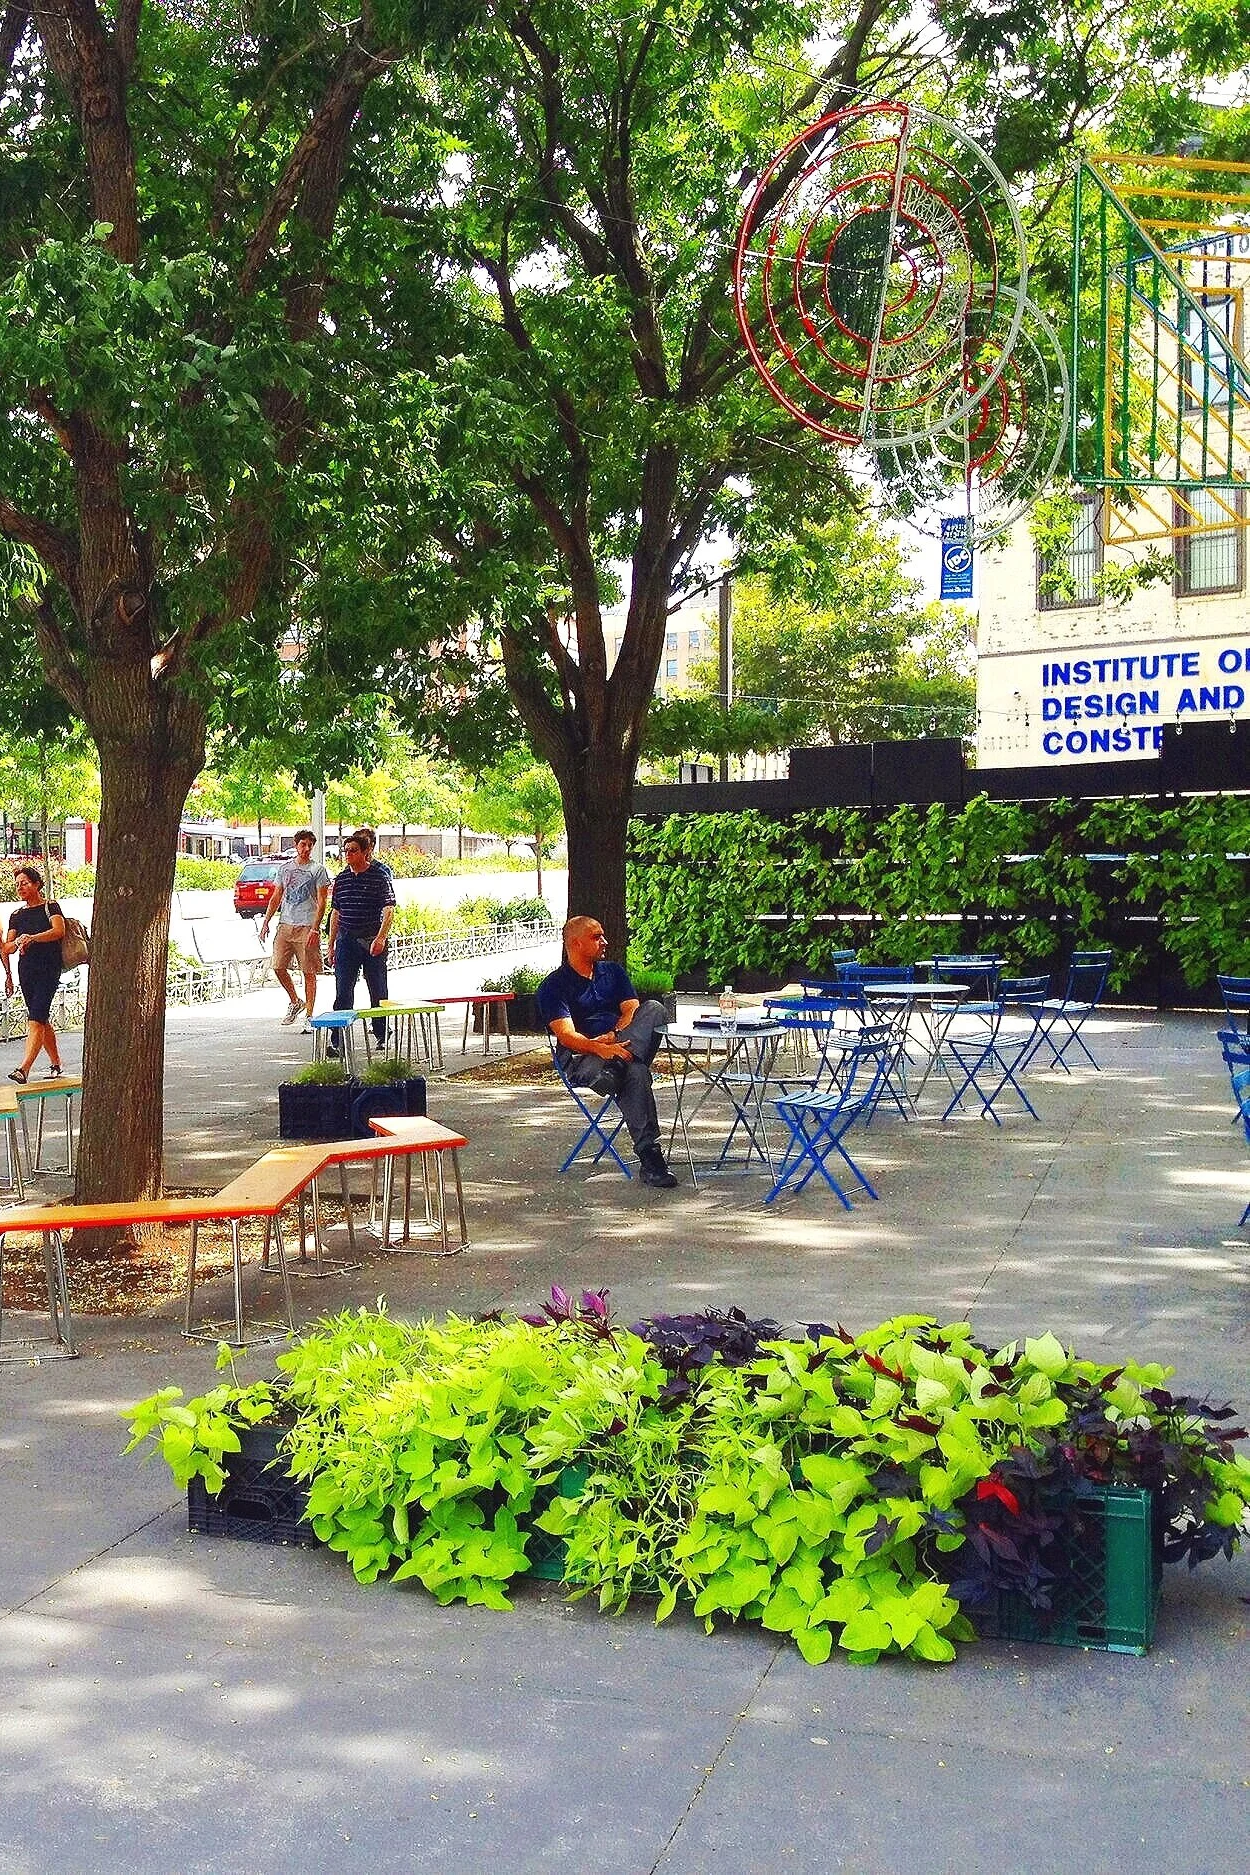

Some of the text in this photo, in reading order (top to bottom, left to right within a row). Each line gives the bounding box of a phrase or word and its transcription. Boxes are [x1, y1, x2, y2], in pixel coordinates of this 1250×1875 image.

[946, 548, 970, 570] IDC
[1042, 648, 1250, 687] INSTITUTE O
[1042, 685, 1245, 721] DESIGN AND
